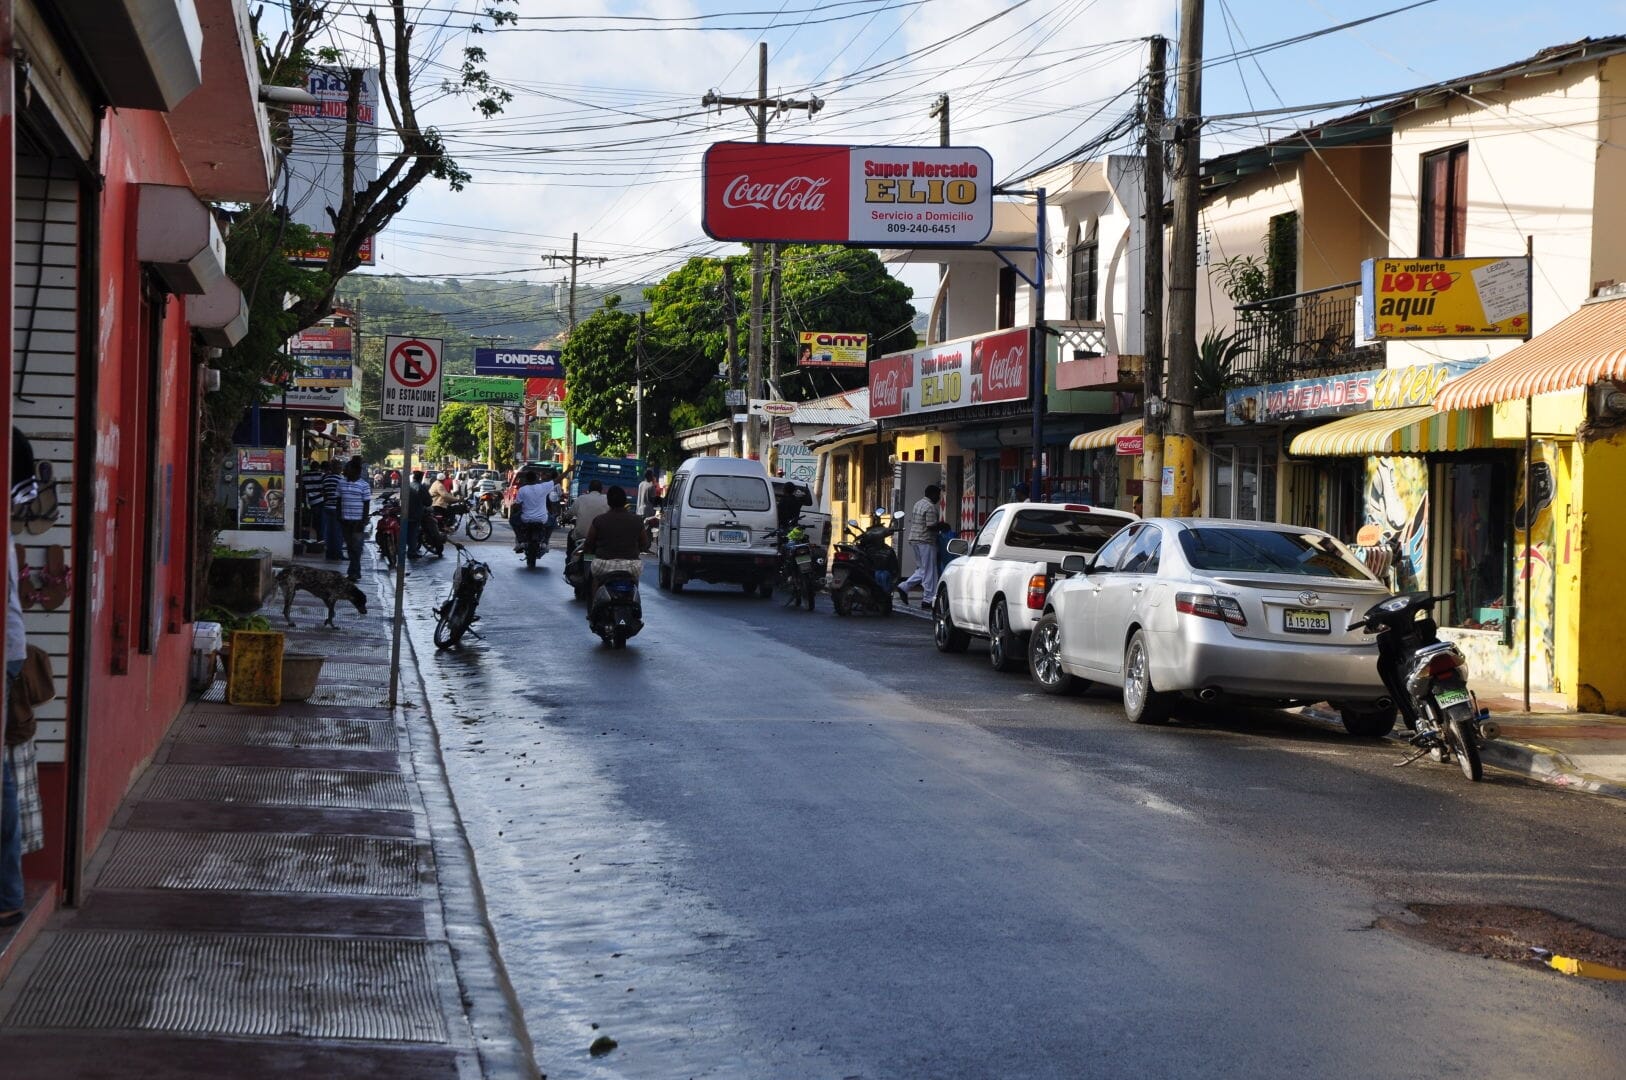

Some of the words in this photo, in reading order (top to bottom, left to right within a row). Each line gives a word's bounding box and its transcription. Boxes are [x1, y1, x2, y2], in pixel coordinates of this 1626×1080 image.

[310, 74, 368, 94] plaa
[321, 102, 372, 122] ANDEON
[865, 160, 909, 178] Super
[912, 161, 977, 178] Mercado
[865, 179, 977, 204] ELIO
[872, 211, 913, 221] Servicio
[916, 213, 922, 221] a
[925, 211, 974, 221] Domicilio
[887, 223, 956, 233] 809-240-6451
[1384, 263, 1400, 272] Pa'
[1404, 263, 1445, 272] volverte
[1381, 272, 1453, 292] LOTO
[1380, 292, 1438, 321] aquí
[496, 354, 554, 365] FONDESA
[921, 358, 938, 375] Super
[938, 351, 962, 371] Mercado
[387, 388, 396, 399] NO
[400, 389, 436, 402] ESTACIONE
[448, 387, 467, 397] Las
[471, 388, 519, 399] Terrenas
[921, 372, 962, 407] ELIO
[1266, 378, 1371, 414] VARIEDADES
[386, 404, 395, 415] DE
[398, 405, 414, 416] ESTE
[417, 406, 435, 418] LADO
